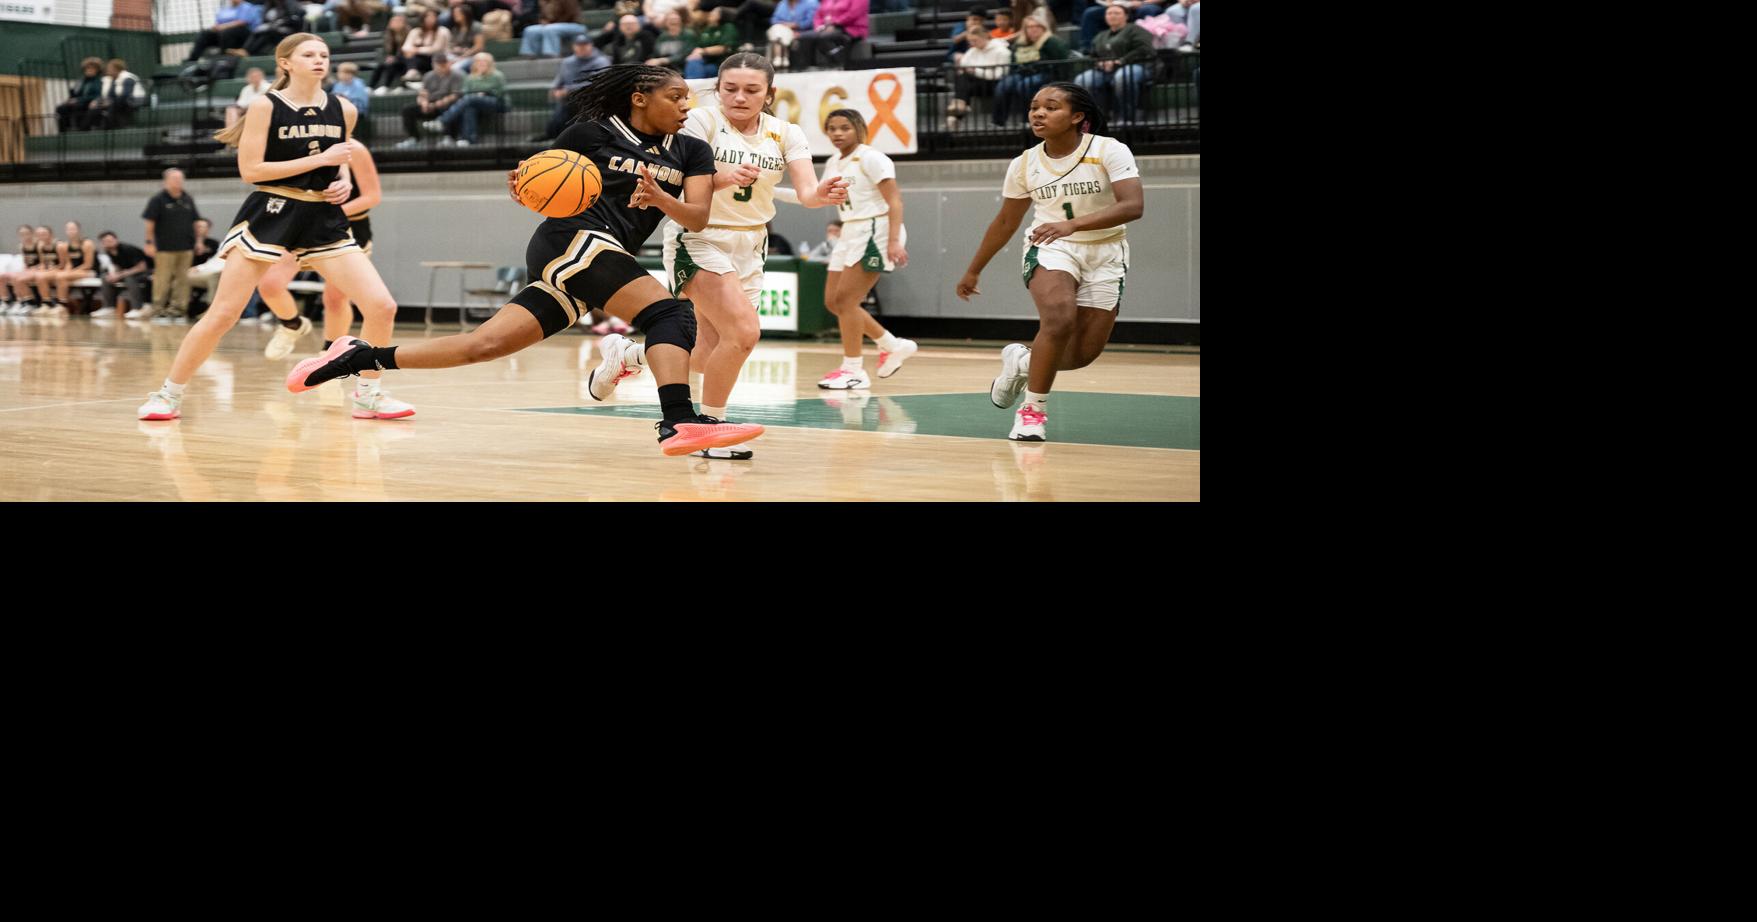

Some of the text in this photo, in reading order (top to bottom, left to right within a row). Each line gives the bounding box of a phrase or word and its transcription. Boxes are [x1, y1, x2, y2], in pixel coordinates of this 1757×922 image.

[714, 146, 745, 165] LADY
[1062, 180, 1101, 197] TIGERS
[1062, 202, 1075, 220] 1
